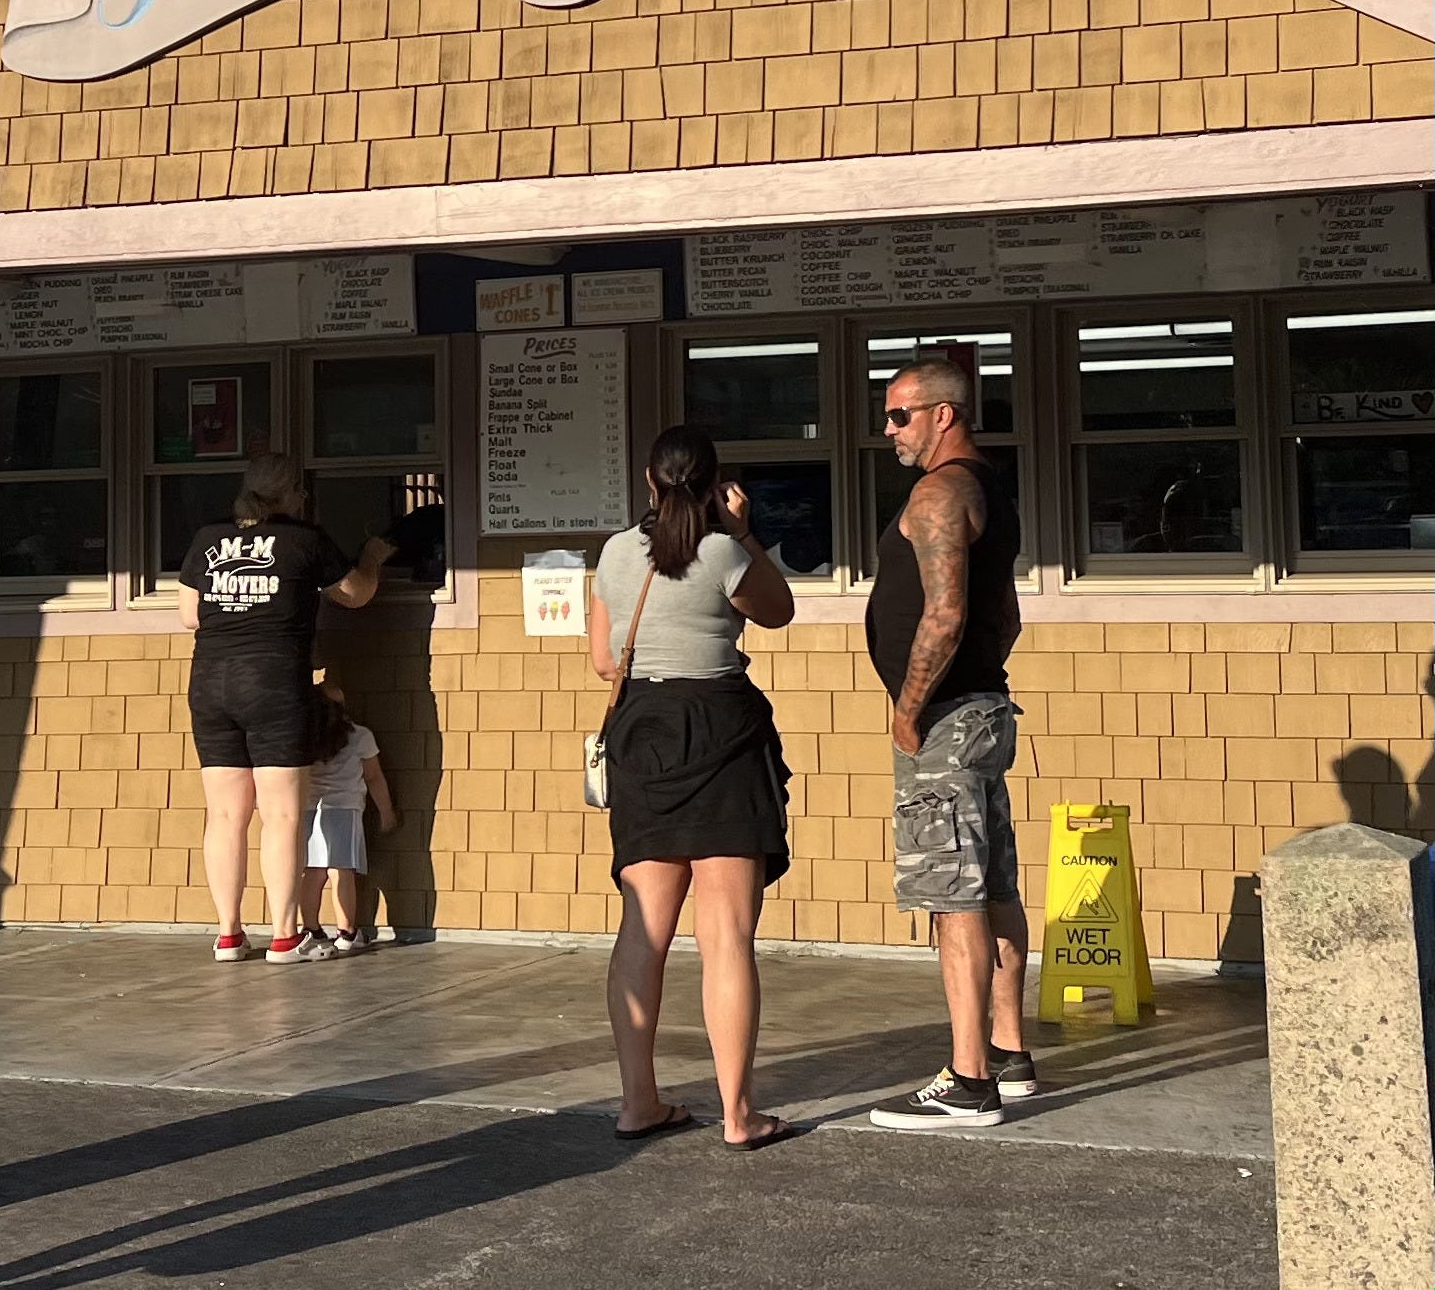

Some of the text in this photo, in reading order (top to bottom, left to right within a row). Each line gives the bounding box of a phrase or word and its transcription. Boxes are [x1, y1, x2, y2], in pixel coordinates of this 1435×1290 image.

[1034, 213, 1077, 224] PINEAPPLE
[996, 228, 1020, 238] OREO
[1326, 231, 1361, 242] COFFEE
[700, 233, 785, 245] BLACK RASPBERRY
[838, 237, 879, 247] WALNUT
[892, 234, 932, 244] GINGER
[700, 245, 751, 255] BLUEBERRY
[894, 243, 956, 254] GRAPE NUT
[700, 253, 785, 266] BUTTER KRUNCH
[801, 250, 852, 260] COCONUT
[801, 261, 840, 271] COFFEE
[899, 256, 937, 266] LEMON
[345, 269, 369, 278] BLACK
[700, 266, 766, 278] BUTTER PECAN
[801, 271, 872, 283] COFFEE CHIP
[894, 267, 976, 278] MAPLE WALNUT
[44, 279, 82, 289] PUDDING
[91, 274, 154, 285] ORANGE PINEAPPLE
[341, 278, 382, 288] CHOCOLATE
[701, 277, 769, 289] BUTTERSCOTCH
[899, 276, 992, 289] MINT CHIP
[93, 285, 113, 295] OREO
[341, 289, 368, 299] COFFEE
[701, 289, 772, 300] CHERRY VANILLA
[801, 283, 884, 295] COOKIE DOUGH
[479, 282, 533, 310] WAFFLE
[801, 296, 846, 306] EGGNOG
[904, 291, 942, 301] MOCHA
[947, 290, 972, 299] CHIP
[12, 300, 59, 310] GRAPE NUT
[701, 301, 753, 311] CHOCOLATE
[15, 310, 43, 319] LEMON
[495, 307, 541, 324] CONES
[10, 319, 74, 329] MAPLE WALNUT
[322, 322, 366, 333] STRAWBERRY
[15, 326, 88, 339] MINT CHIP
[19, 340, 49, 349] MOCHA
[53, 338, 73, 348] CHIP
[524, 337, 577, 355] PRICES
[489, 361, 578, 374] Small Cone or Box
[488, 374, 579, 388] Large Cone or Box
[489, 388, 523, 398] Sundae
[489, 398, 547, 411] Banana Split
[488, 410, 574, 424] Frappe or Cabinet
[488, 423, 553, 435] Extra Thick
[488, 436, 512, 447] Malt
[488, 448, 526, 458] Freeze
[488, 459, 517, 470] Float
[488, 471, 518, 482] Soda
[488, 492, 512, 503] Pints
[488, 504, 520, 515] Quarts
[489, 519, 507, 529] Half
[512, 518, 548, 529] Gallons
[552, 517, 565, 528] (in
[570, 516, 599, 528] store)
[219, 535, 276, 561] M-M
[211, 570, 280, 595] MOVERS
[1061, 855, 1118, 867] CAUTION
[1066, 927, 1112, 945] WET
[1055, 947, 1122, 966] FLOOR
